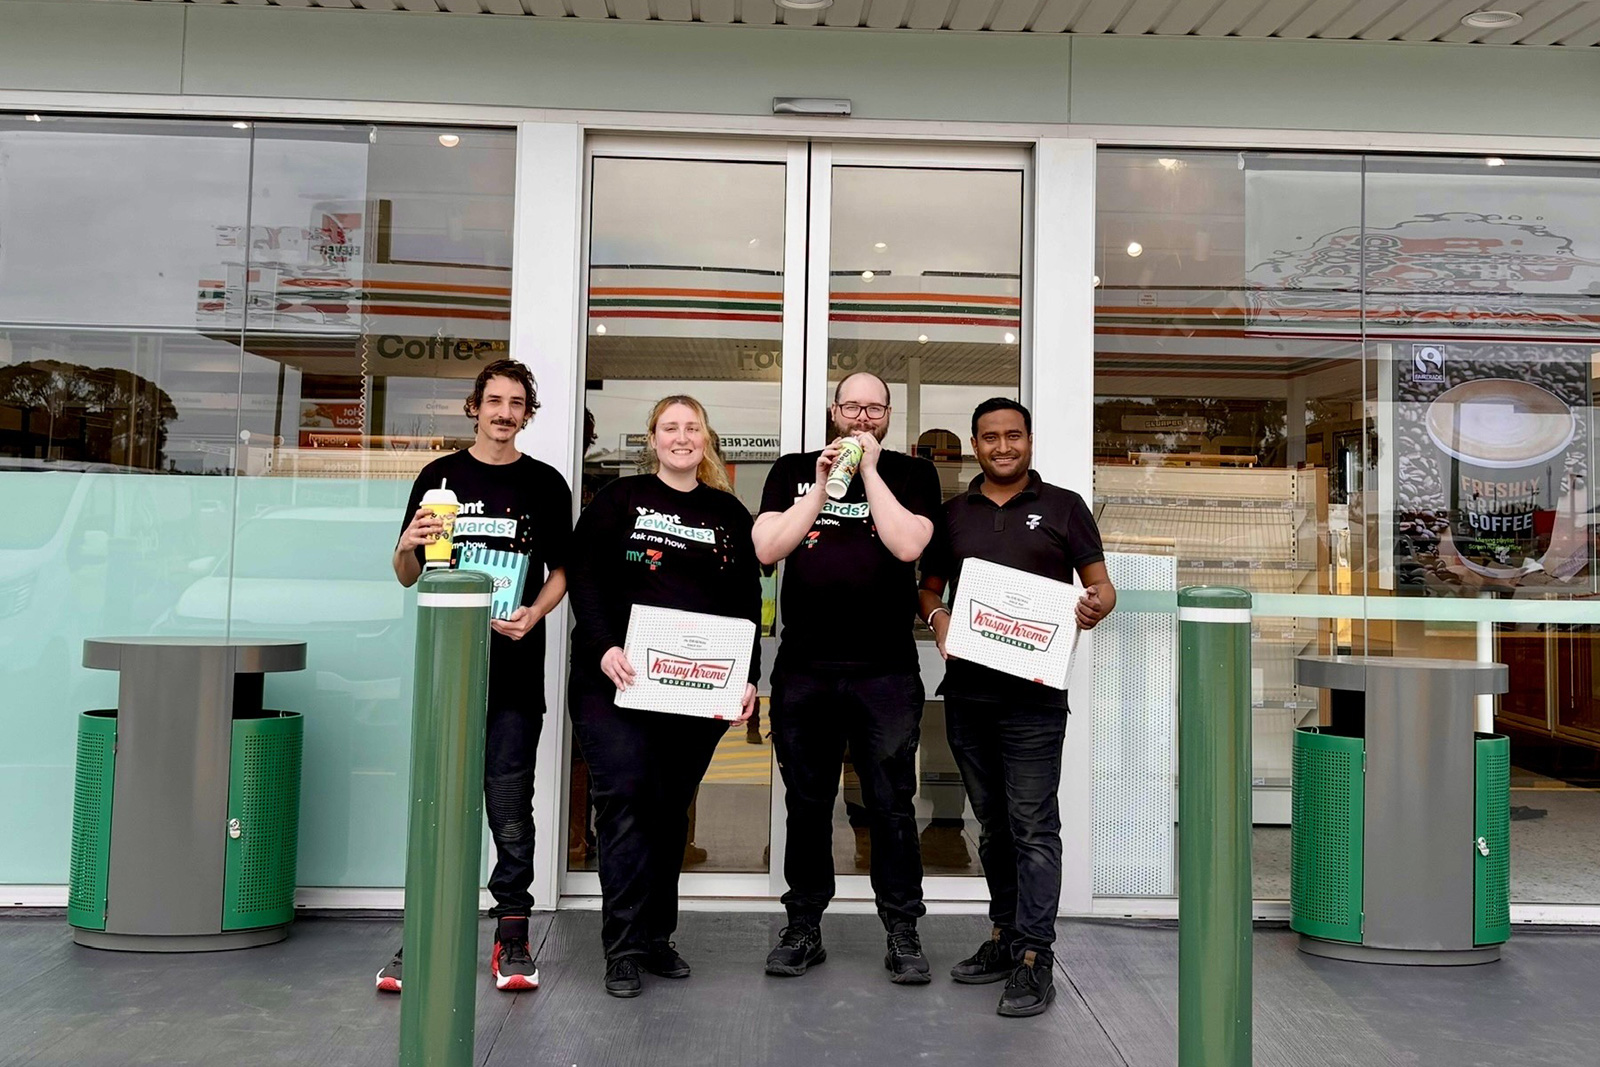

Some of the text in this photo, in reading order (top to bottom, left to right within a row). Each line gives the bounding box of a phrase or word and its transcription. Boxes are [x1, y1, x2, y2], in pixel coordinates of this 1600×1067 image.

[738, 350, 783, 369] Fo
[1461, 475, 1540, 498] FRESHLY
[457, 500, 484, 514] ant
[822, 503, 868, 516] ards?
[1466, 493, 1537, 516] GROUND
[455, 520, 515, 535] wards?
[637, 517, 713, 541] rewards?
[1468, 511, 1533, 532] COFFEE
[630, 532, 687, 550] Ask me how.
[973, 609, 1051, 644] Krispy Kreme
[983, 631, 1033, 651] DOUGHNUTS
[651, 657, 729, 681] Krispy Kreme
[662, 678, 712, 689] DOUGHNUTS
